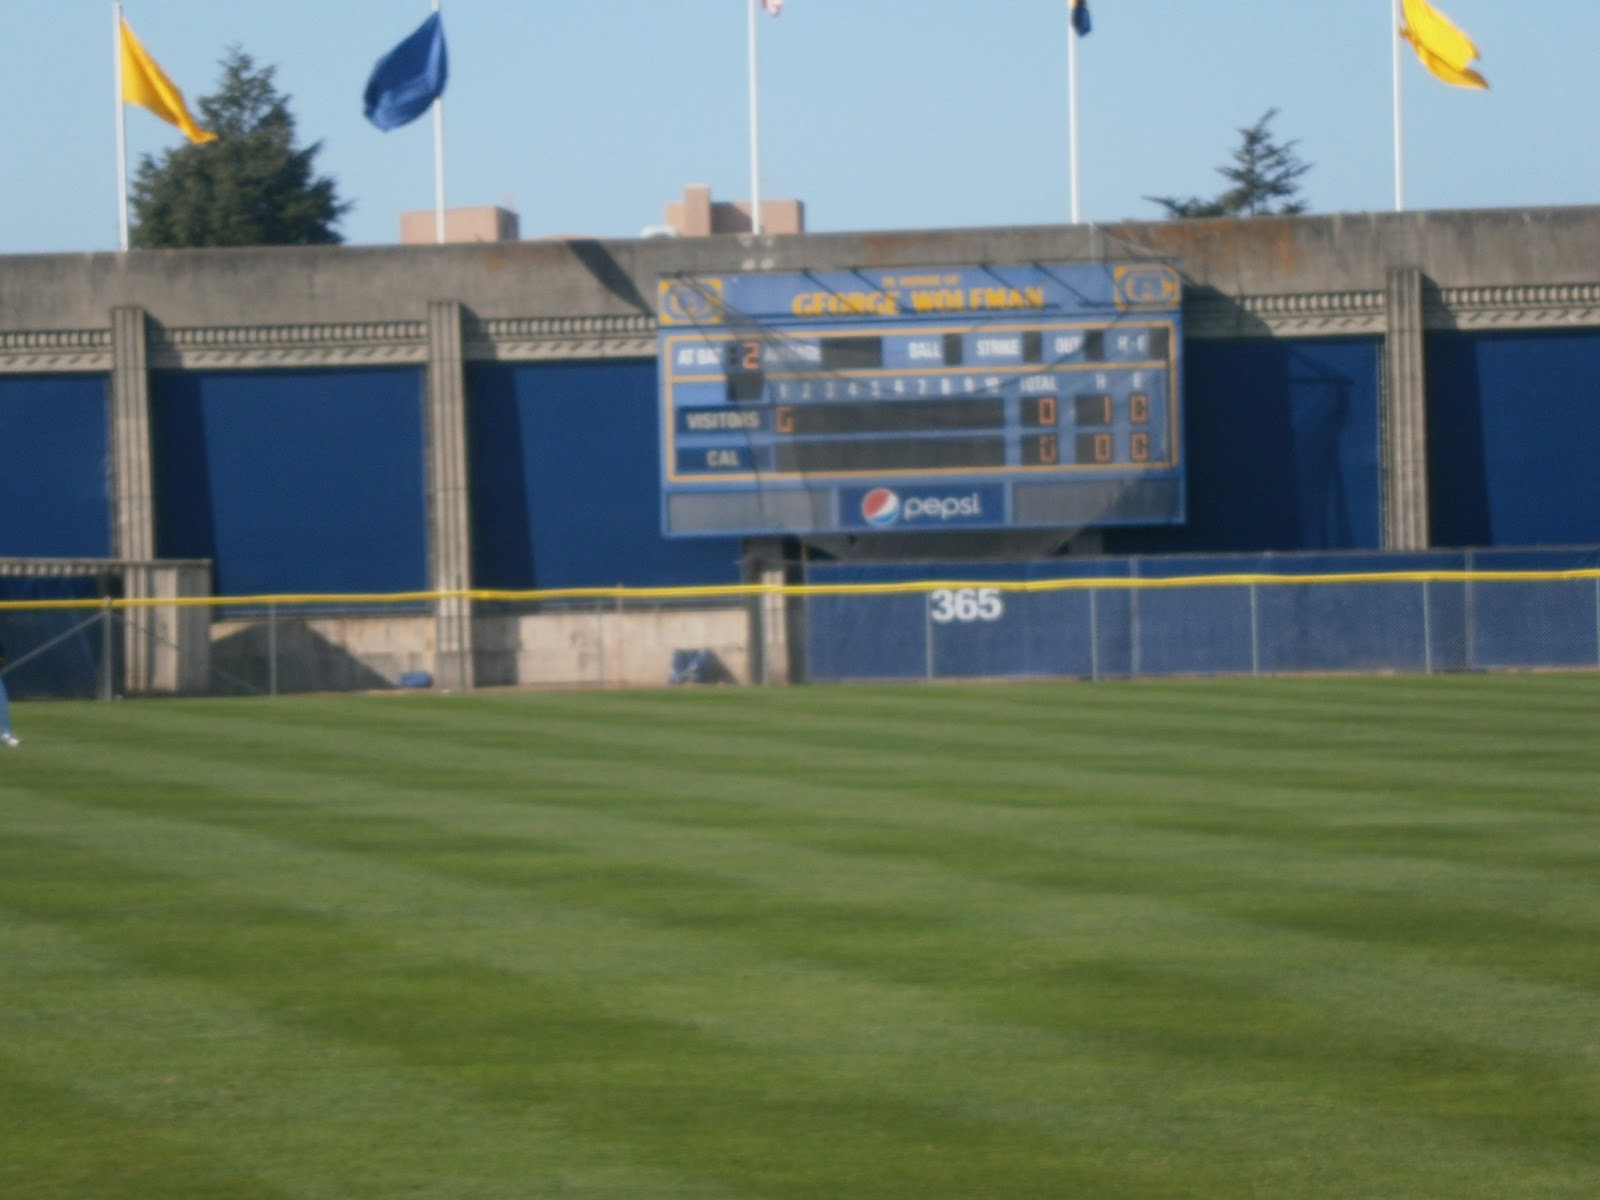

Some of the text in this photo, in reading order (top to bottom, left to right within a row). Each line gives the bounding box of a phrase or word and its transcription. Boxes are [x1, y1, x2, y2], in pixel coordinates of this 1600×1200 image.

[742, 341, 761, 369] 2
[686, 411, 760, 430] VISITORS
[706, 450, 740, 468] CAL
[1094, 433, 1112, 462] 0
[904, 493, 981, 519] pepsi
[931, 588, 1003, 622] 365
